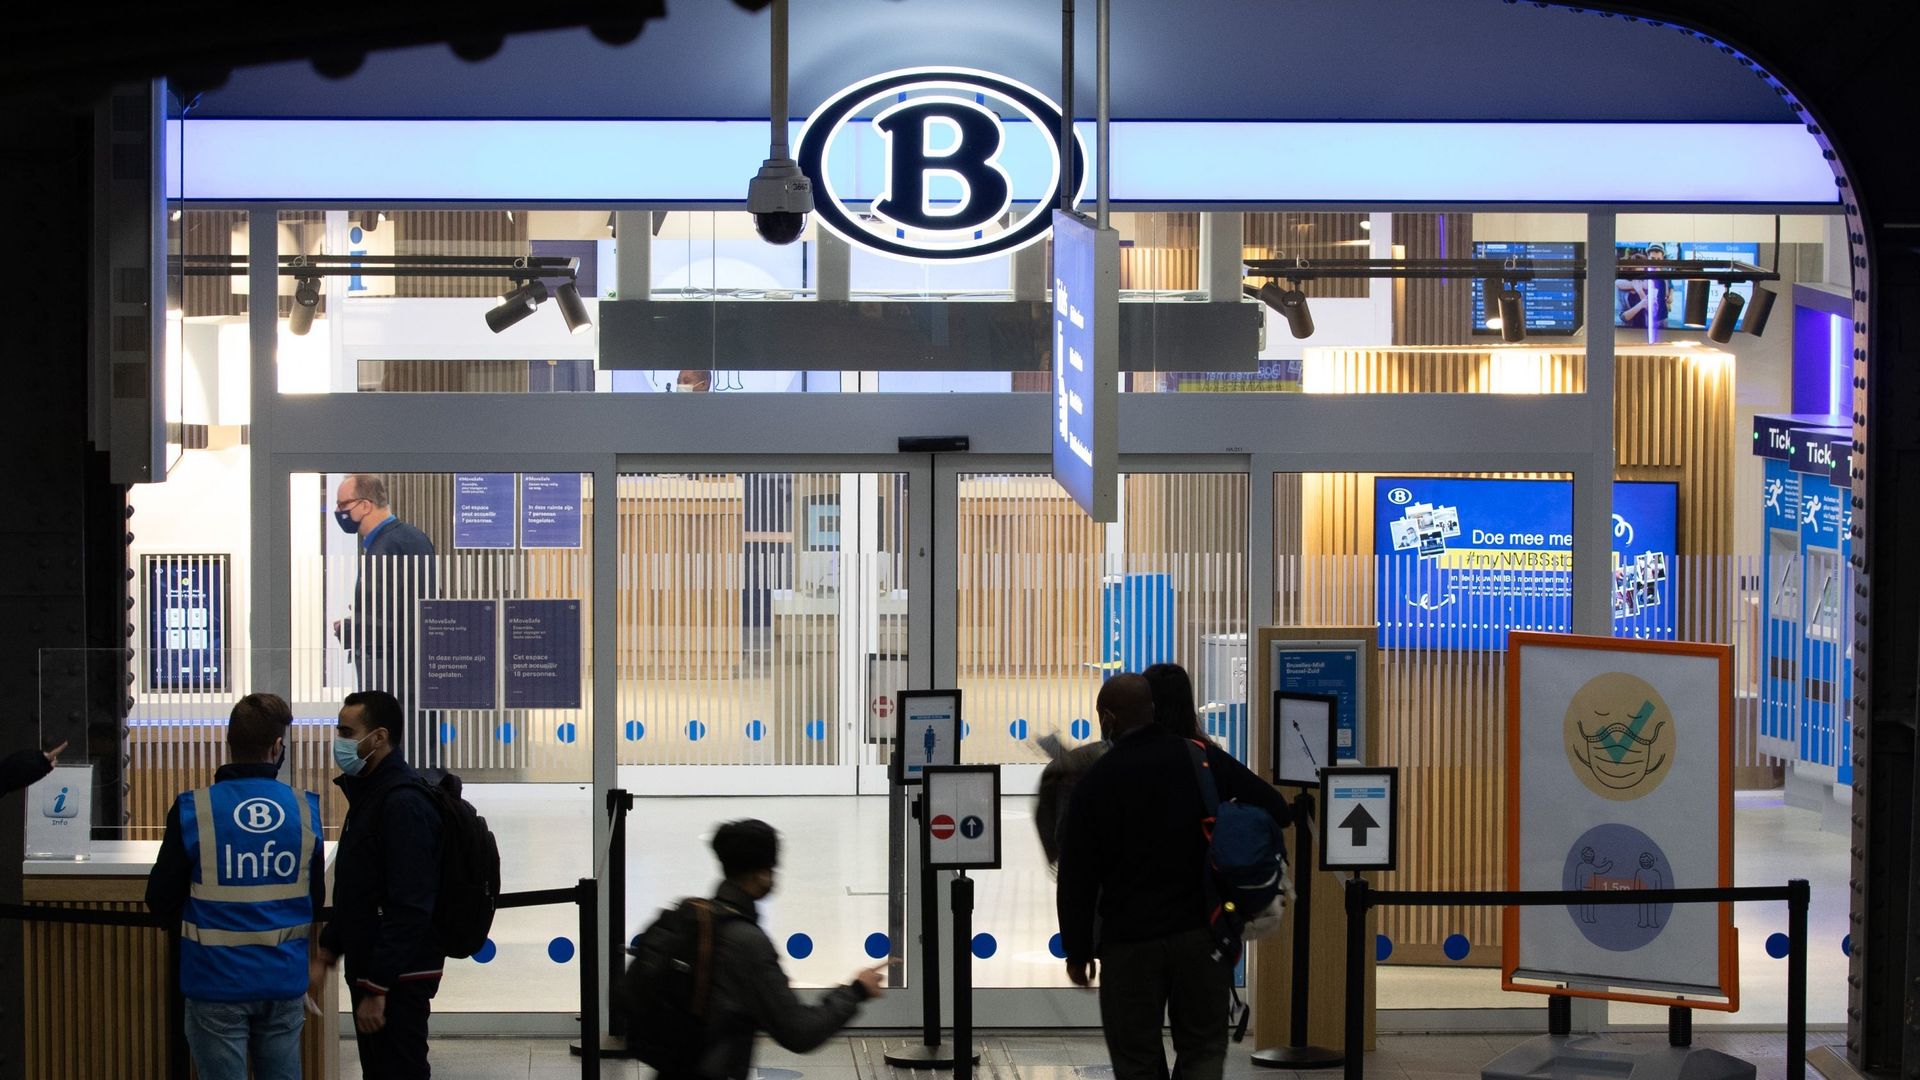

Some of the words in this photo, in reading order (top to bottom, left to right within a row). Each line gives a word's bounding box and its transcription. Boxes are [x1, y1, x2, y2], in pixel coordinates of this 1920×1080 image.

[1472, 529, 1505, 545] Doe
[1509, 533, 1544, 545] mee
[225, 840, 296, 879] Info
